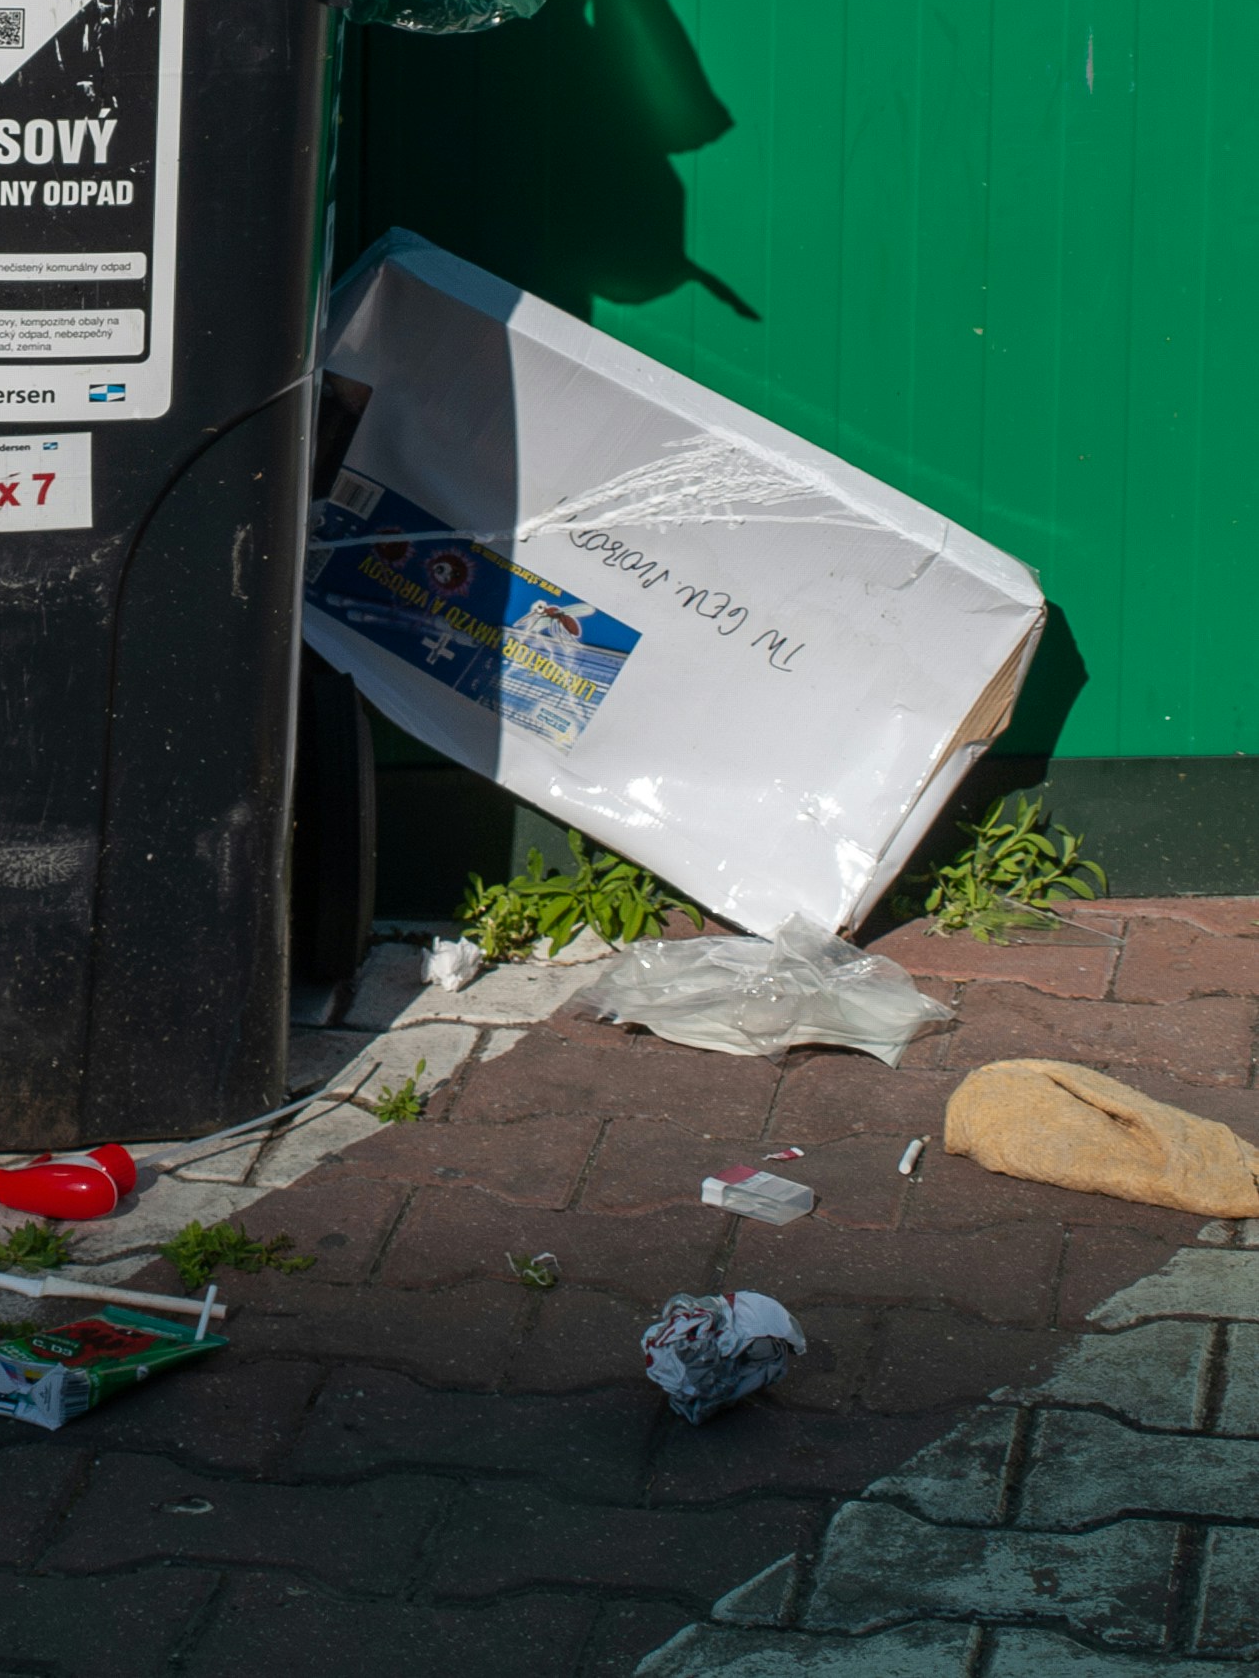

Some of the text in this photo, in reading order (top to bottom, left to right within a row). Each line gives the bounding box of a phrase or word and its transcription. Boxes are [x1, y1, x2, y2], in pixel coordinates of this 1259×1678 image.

[43, 179, 134, 206] ODPAD
[46, 261, 98, 274] komunálny
[100, 261, 132, 273] odpad
[20, 316, 76, 328] kompozitné
[78, 316, 105, 328] obaly
[107, 318, 120, 326] na
[18, 329, 52, 340] odpad,
[54, 328, 113, 340] nebezpečný
[16, 342, 52, 352] zemina
[32, 472, 56, 505] 7
[431, 599, 447, 614] A
[445, 605, 503, 650] HMYZU
[502, 637, 598, 702] LIKVIDÁTOR
